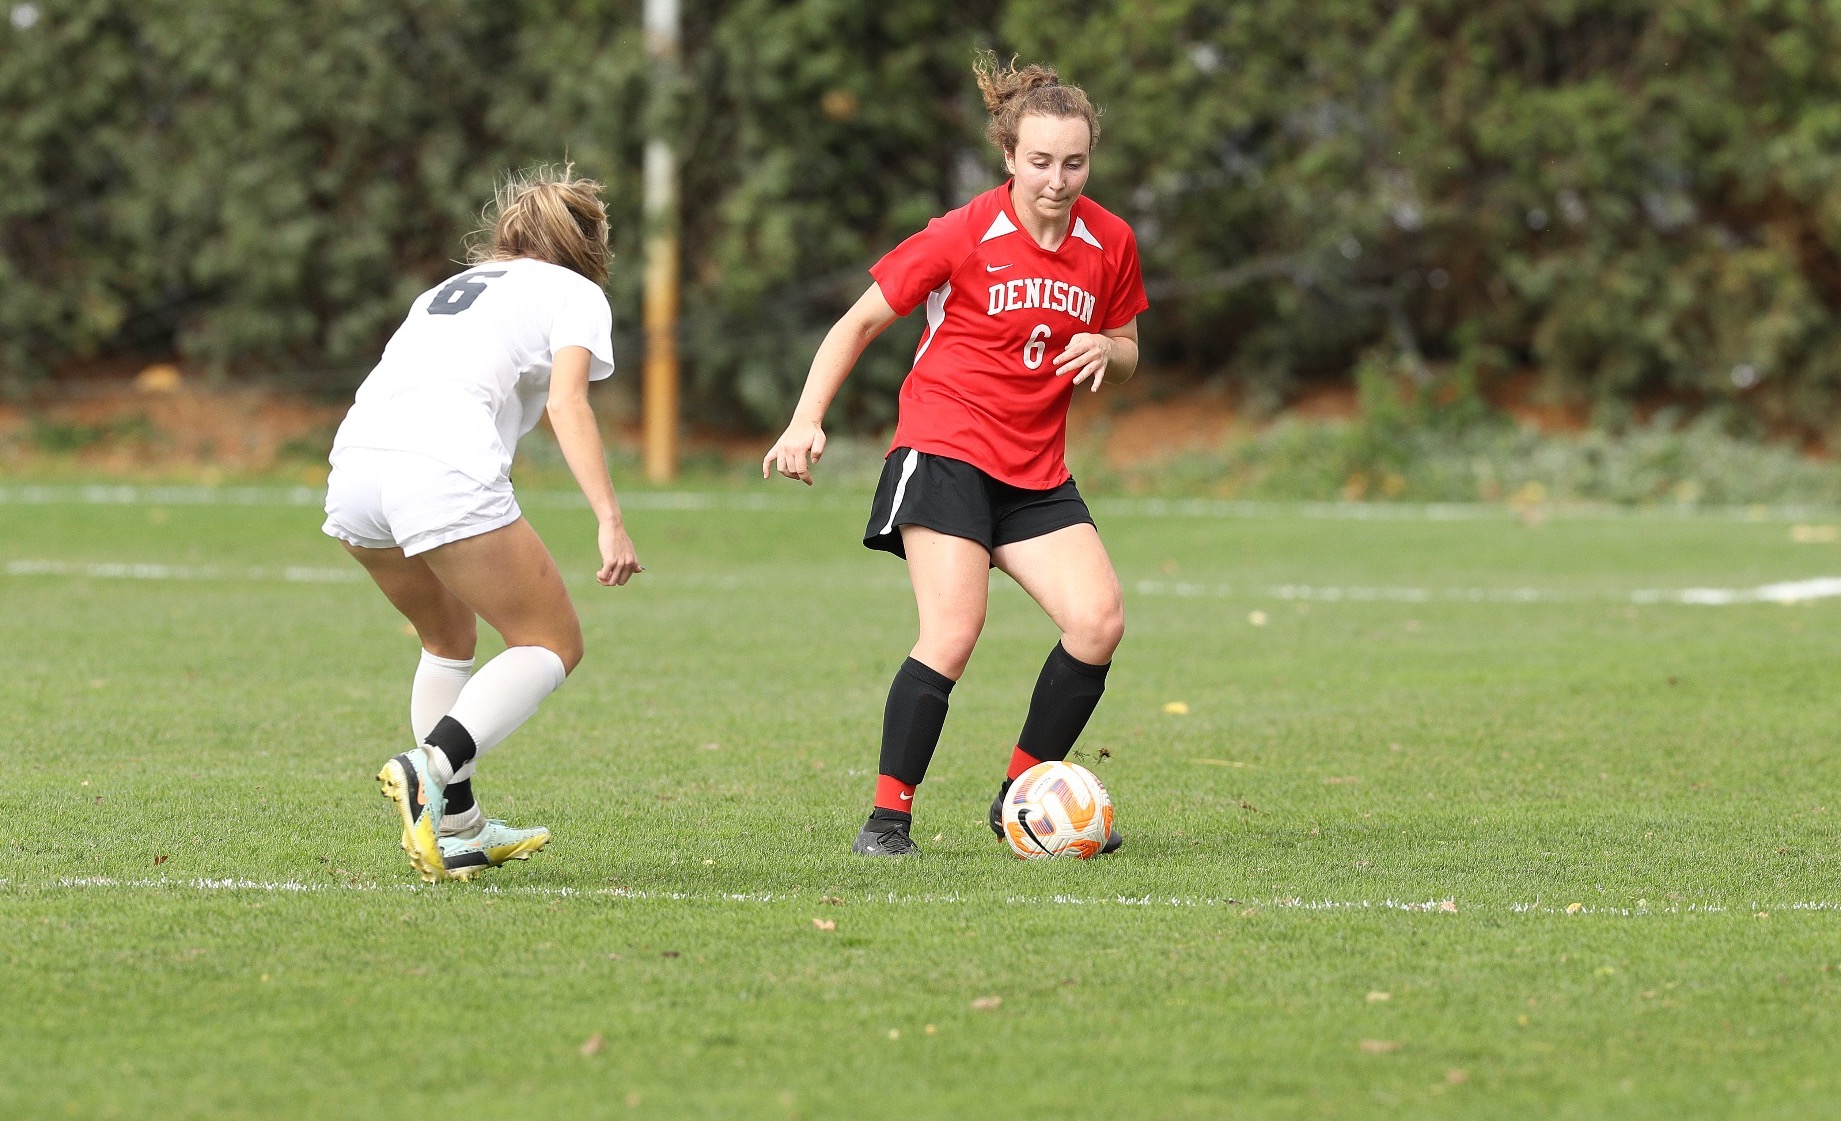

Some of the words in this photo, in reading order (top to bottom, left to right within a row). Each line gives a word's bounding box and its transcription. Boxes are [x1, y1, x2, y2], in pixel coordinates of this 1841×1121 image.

[427, 270, 508, 315] 6
[987, 278, 1096, 325] DENISON
[1023, 323, 1052, 370] 6
